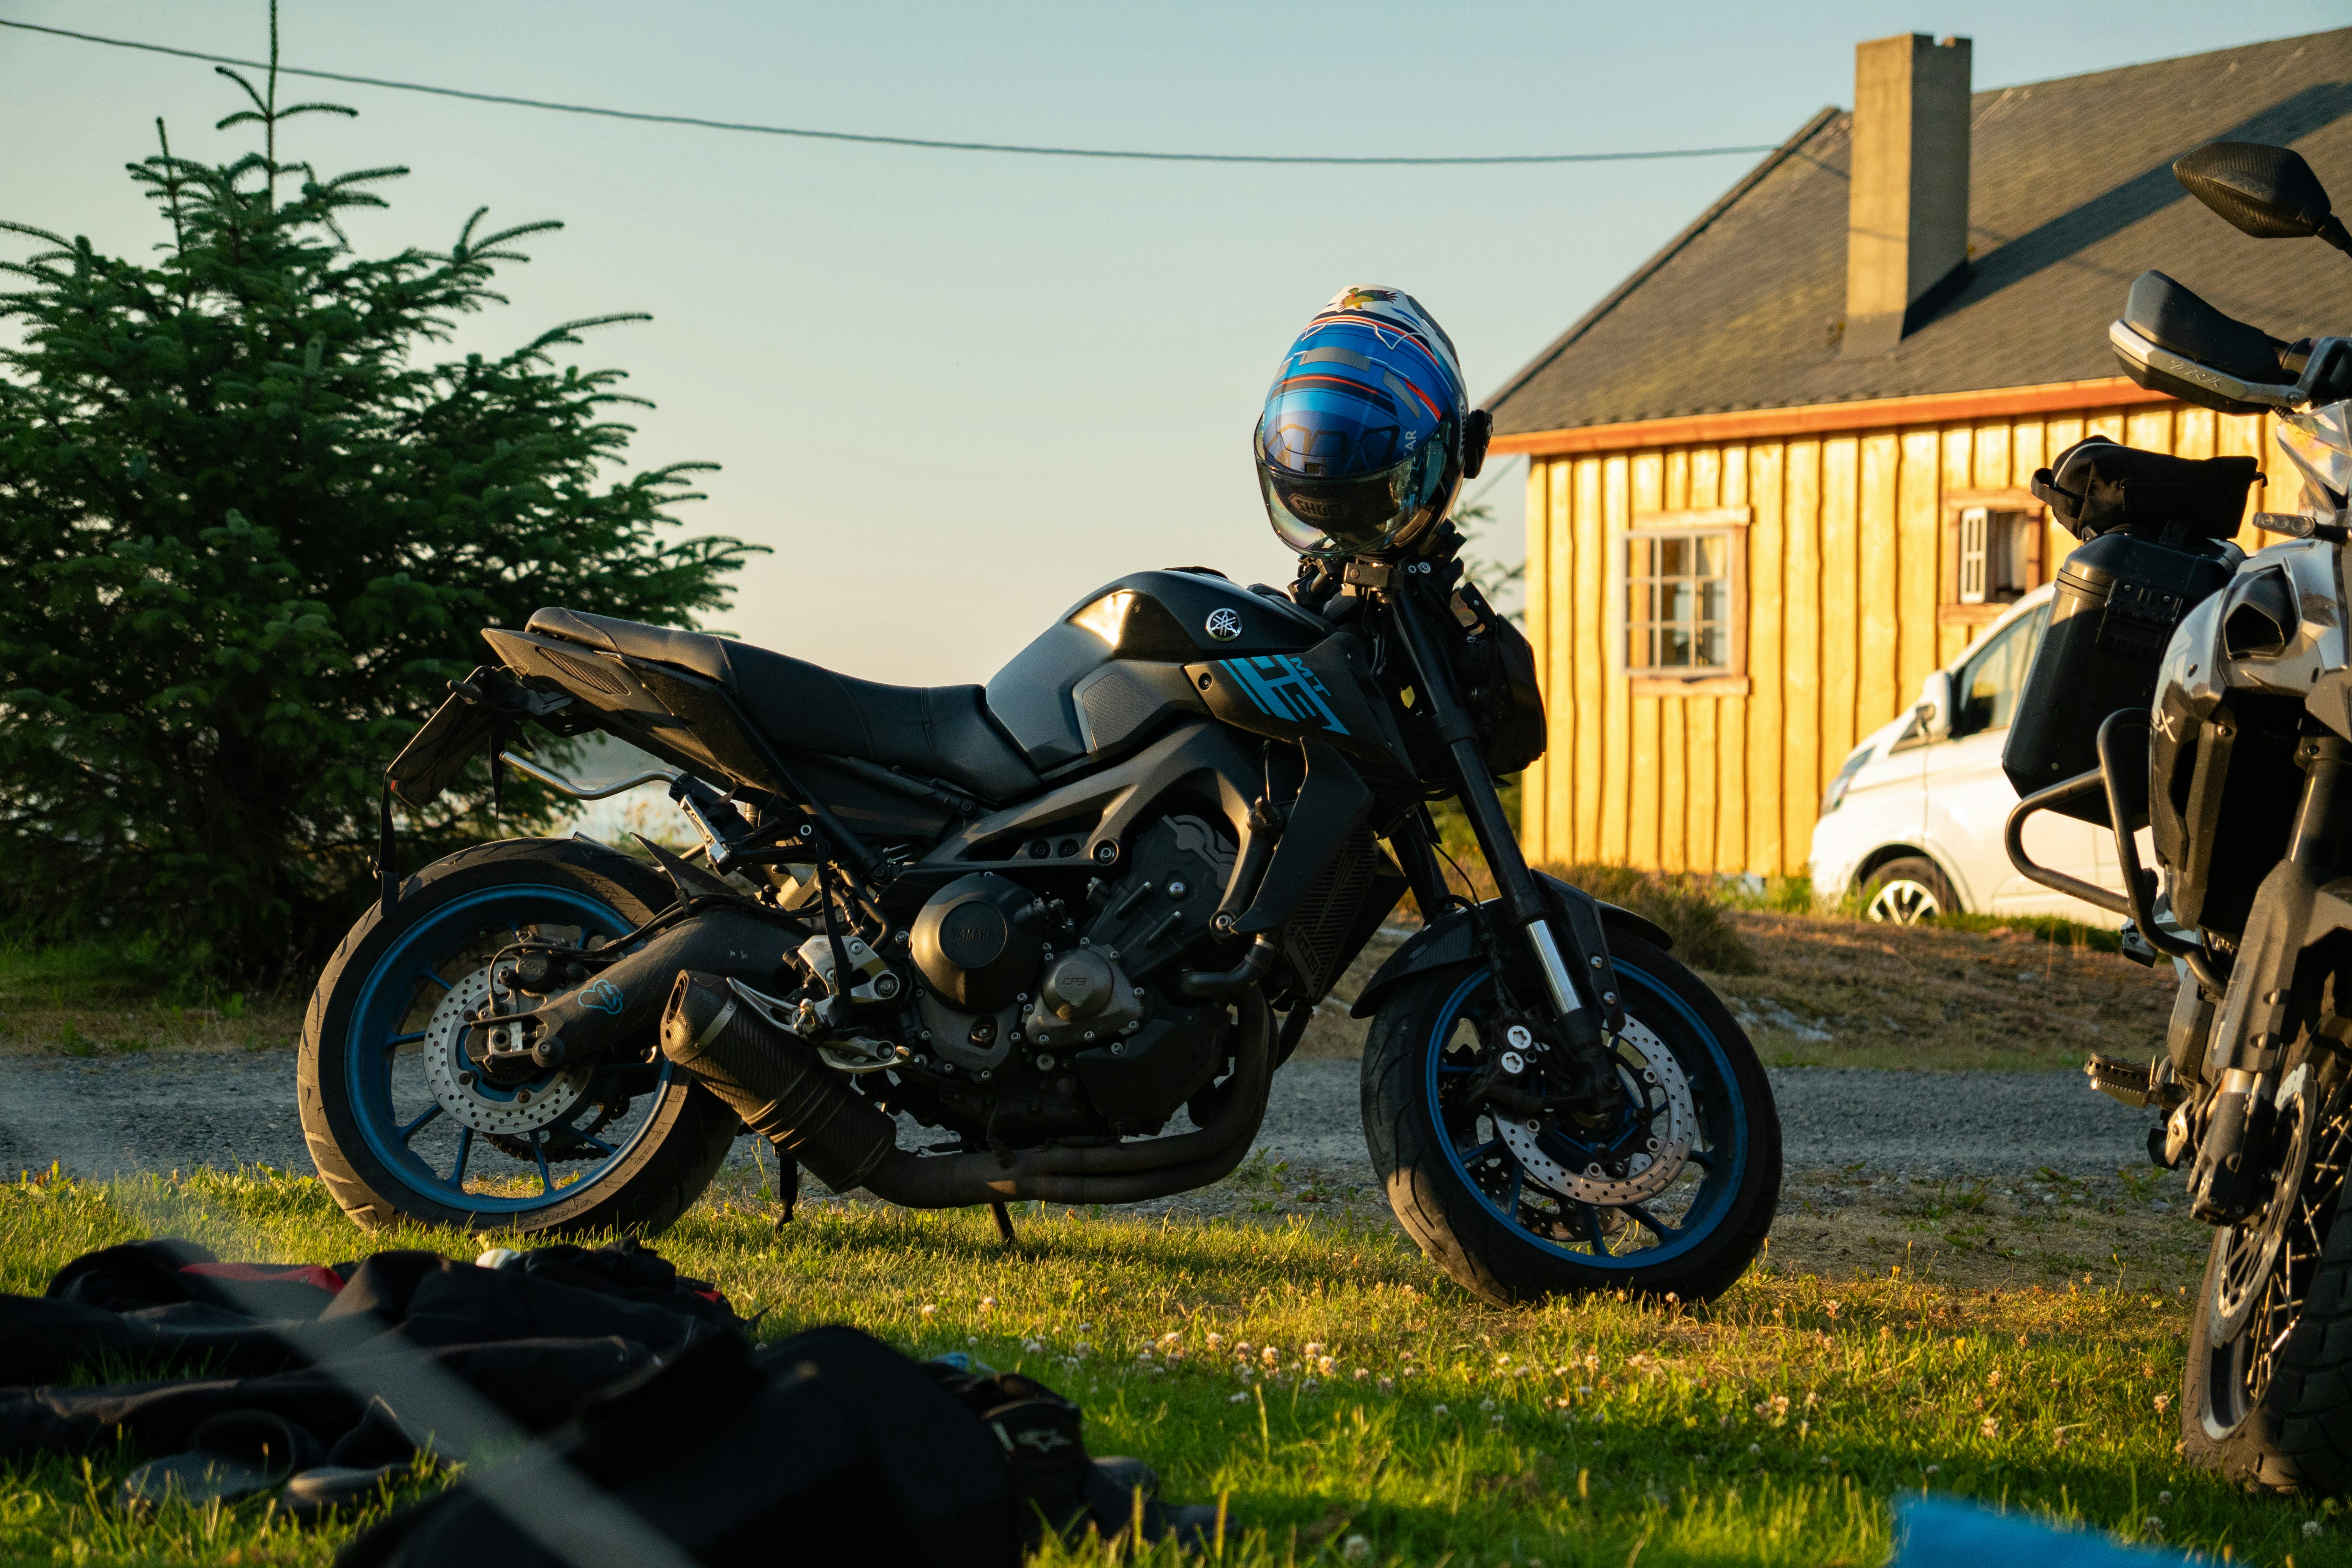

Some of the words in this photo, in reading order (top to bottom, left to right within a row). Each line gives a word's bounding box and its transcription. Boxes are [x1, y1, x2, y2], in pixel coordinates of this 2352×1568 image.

[1404, 430, 1417, 457] AR
[1296, 499, 1343, 517] SHOEI
[1289, 657, 1331, 697] MT
[951, 928, 995, 940] YAMAHA
[519, 959, 545, 972] NISSIN
[596, 986, 614, 1009] TERMIGNONI
